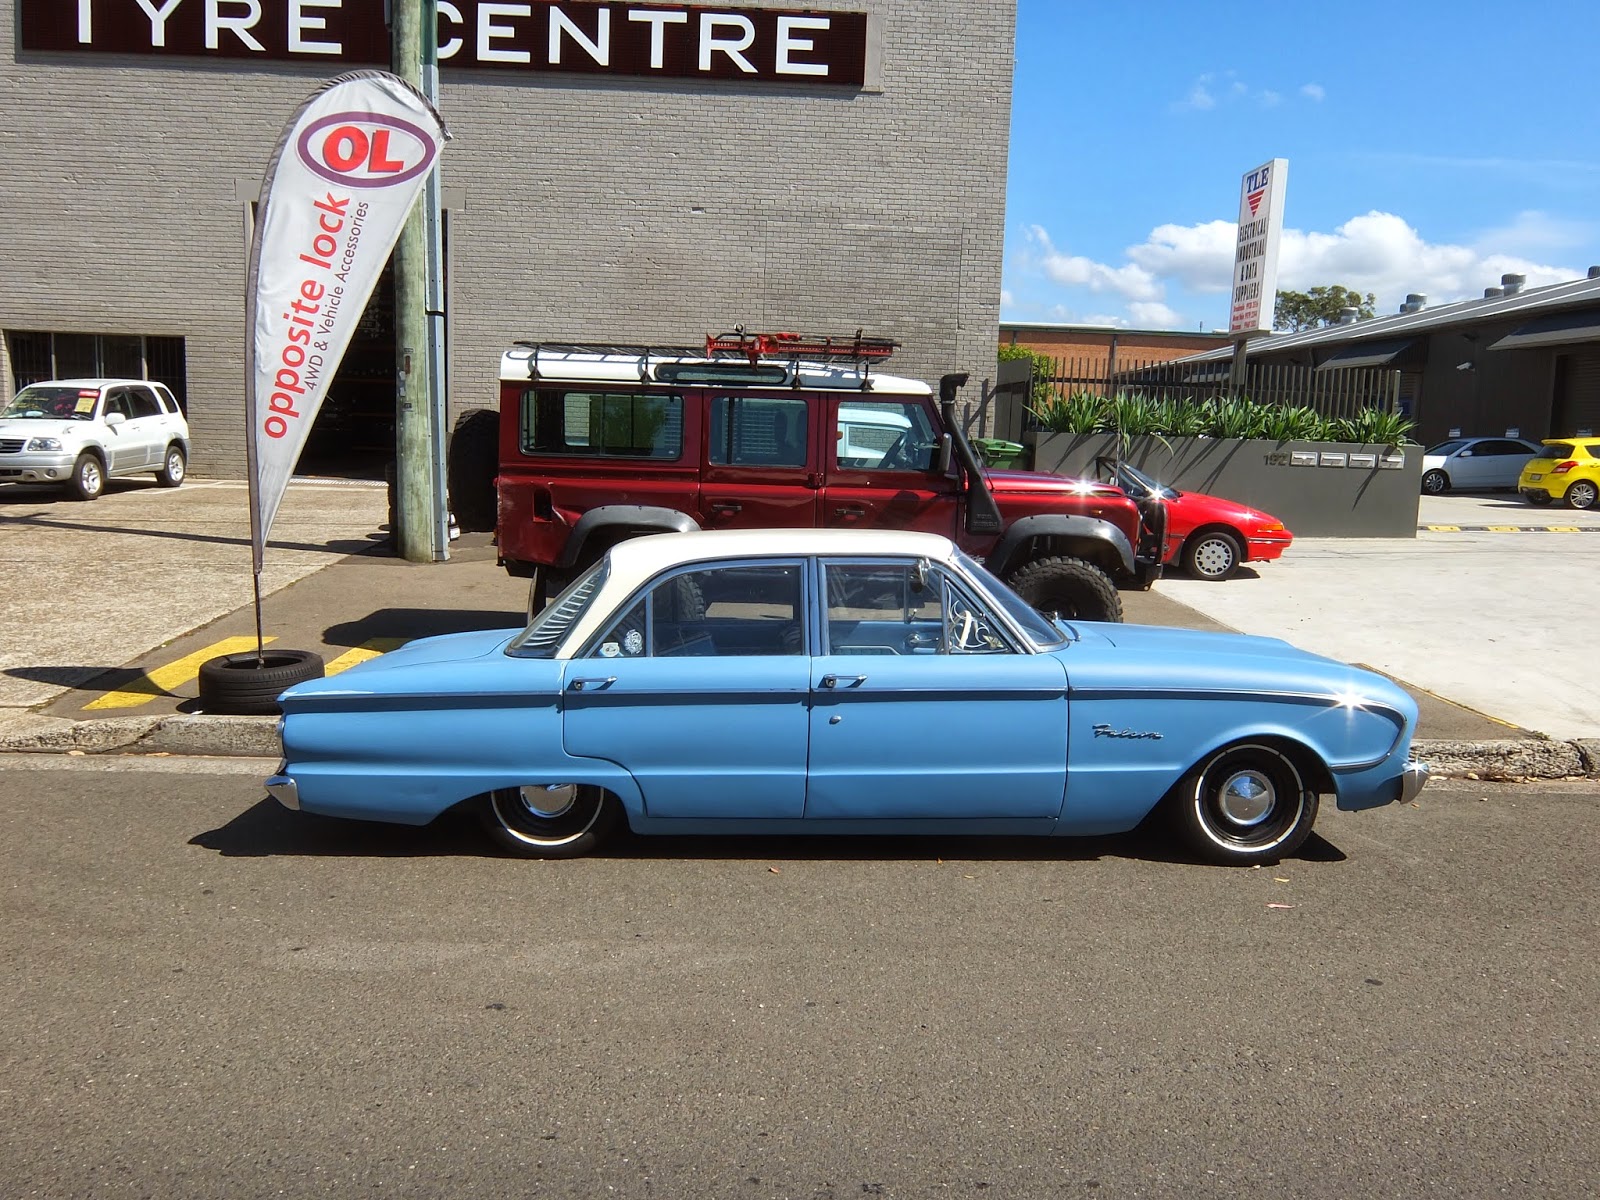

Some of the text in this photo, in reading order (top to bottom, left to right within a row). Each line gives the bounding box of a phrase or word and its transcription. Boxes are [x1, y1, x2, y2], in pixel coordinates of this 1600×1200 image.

[322, 125, 404, 173] OL
[1246, 166, 1270, 194] TLE
[1239, 217, 1266, 242] ELECTRICAL
[1236, 238, 1265, 263] INDUSTRIAL
[1245, 261, 1258, 281] DATA
[304, 201, 369, 391] 4WD & Vehicle Accessories
[1234, 281, 1260, 303] SUPPLIERS
[264, 191, 350, 438] opposite lock
[1092, 723, 1164, 740] Falcon
